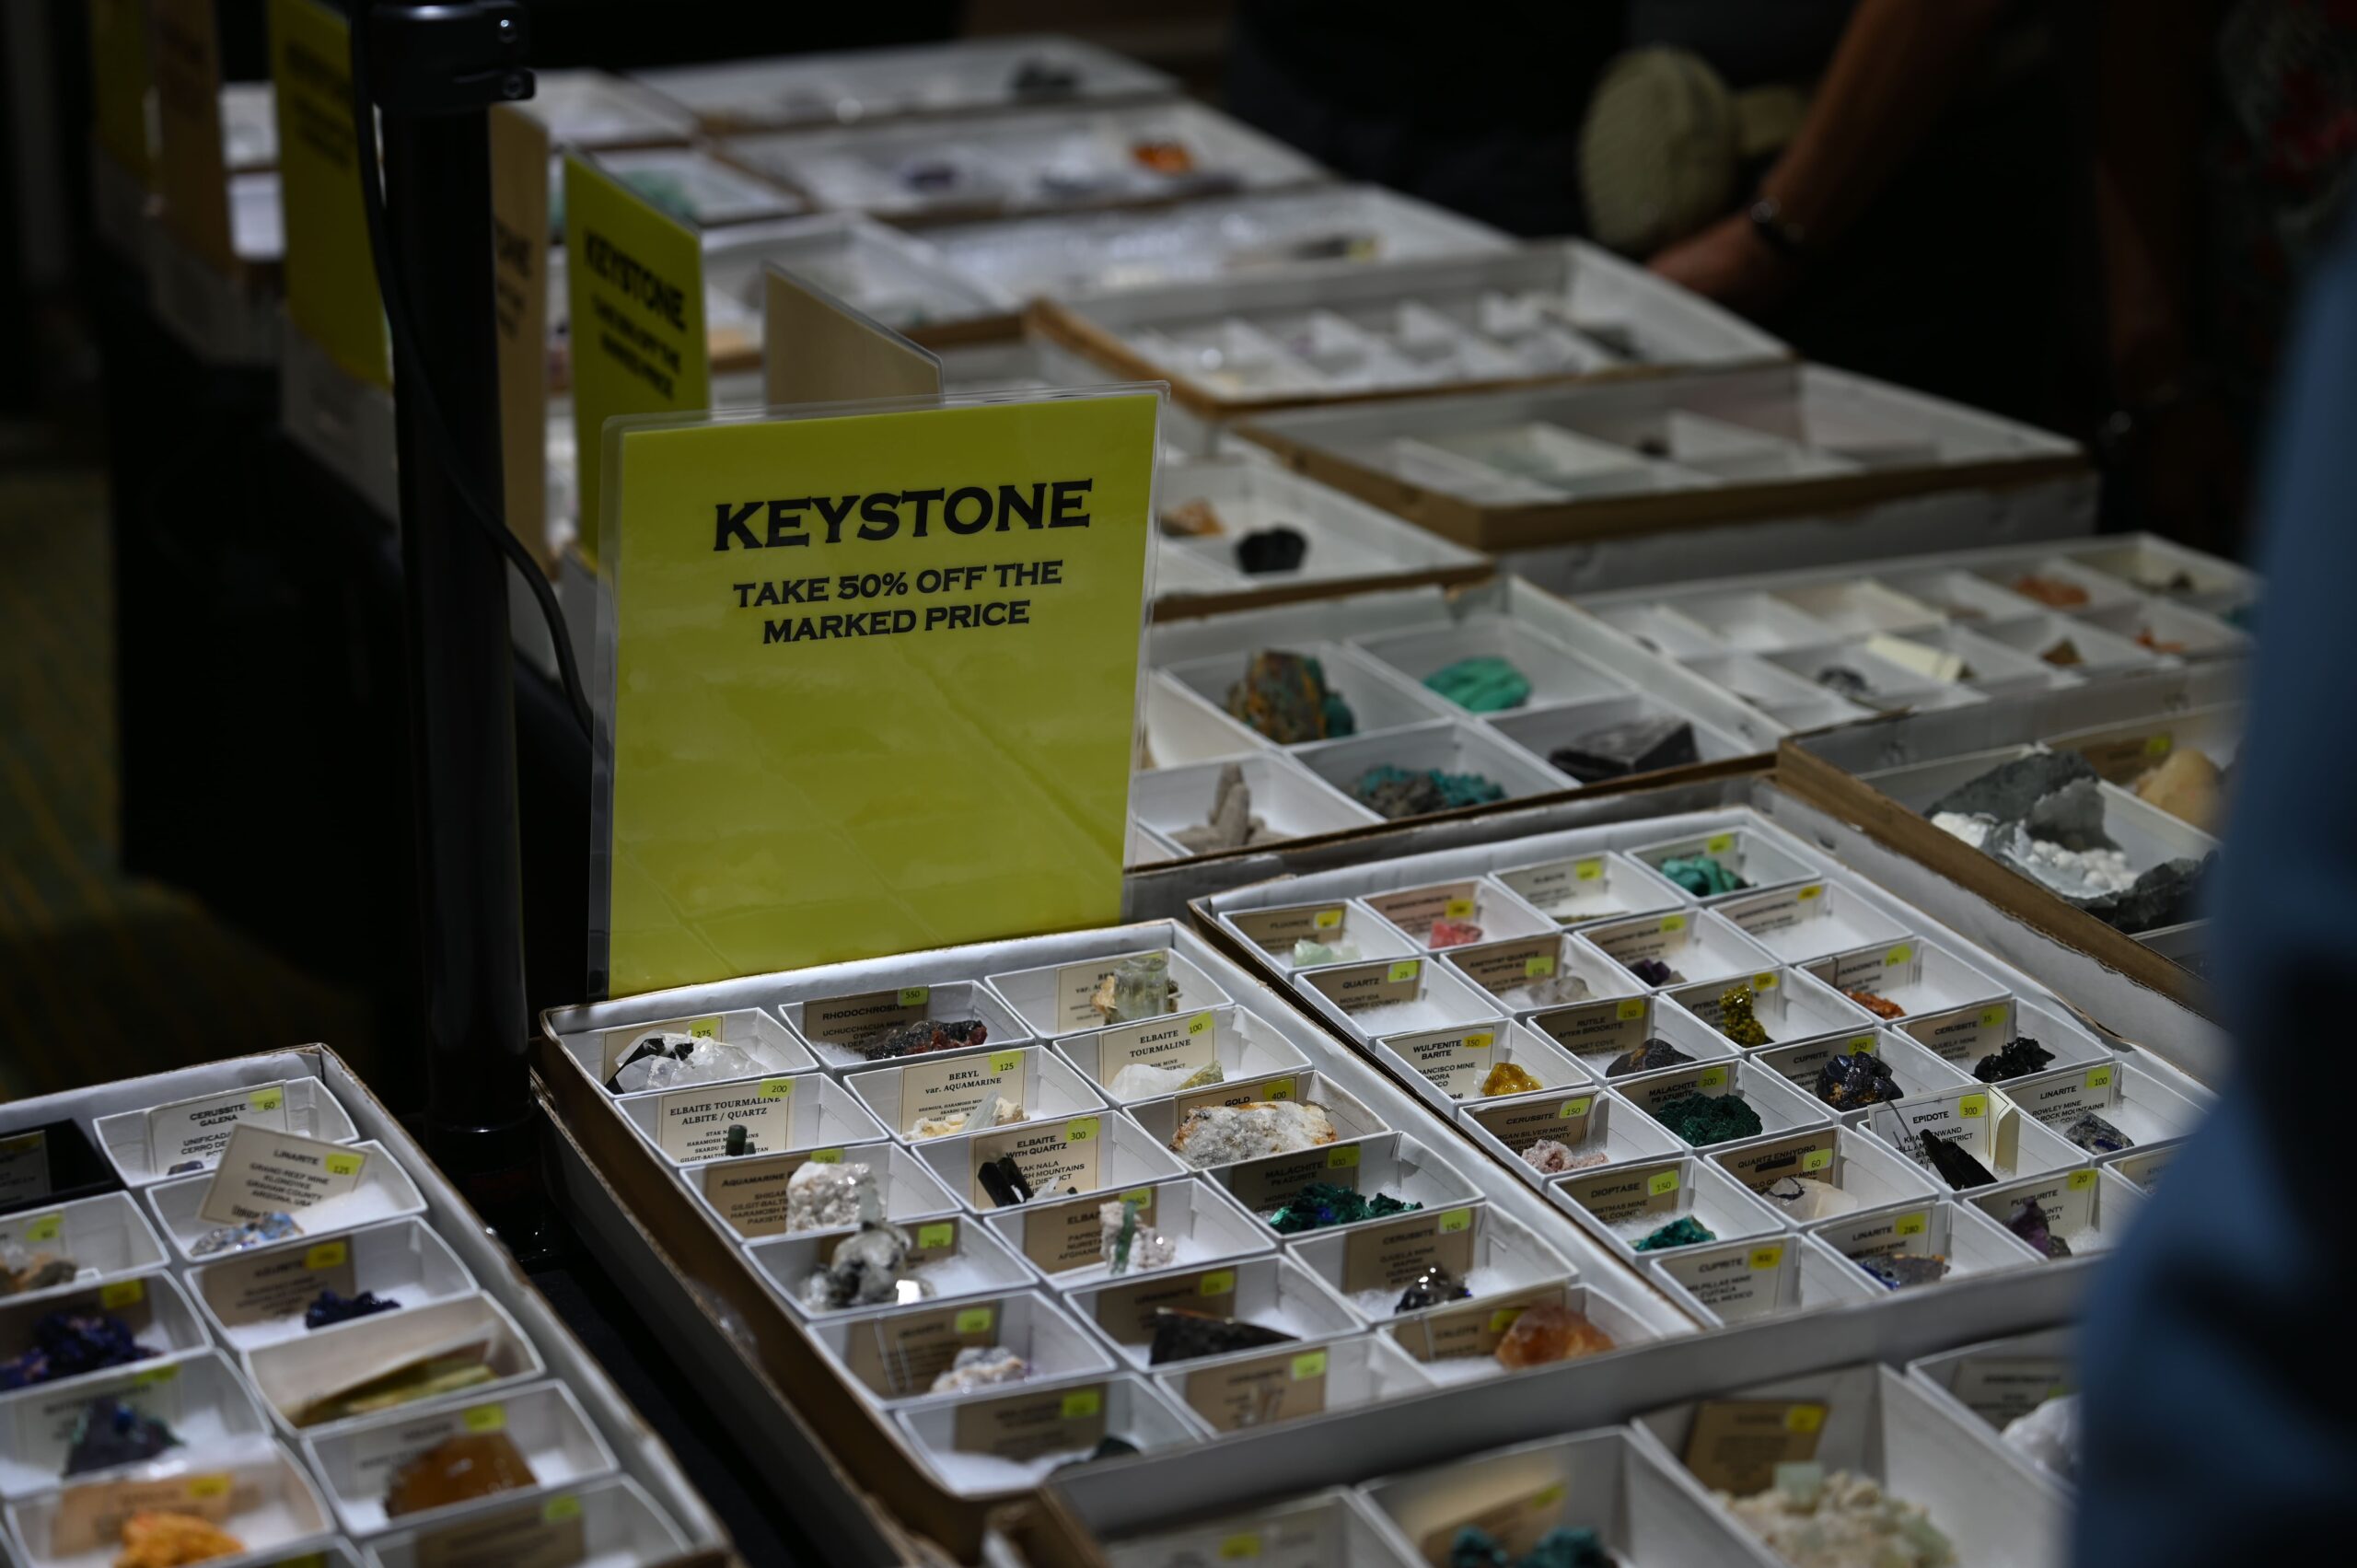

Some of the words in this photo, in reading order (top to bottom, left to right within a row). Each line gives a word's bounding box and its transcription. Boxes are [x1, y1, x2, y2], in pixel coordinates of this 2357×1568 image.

[585, 228, 687, 333] KEYSTONE
[714, 478, 1093, 552] KEYSTONE
[733, 576, 830, 609] TAKE
[838, 571, 909, 600] 50%
[916, 564, 988, 595] OFF
[993, 559, 1063, 587] THE
[762, 609, 917, 645] MARKED
[924, 599, 1030, 632] PRICE
[1342, 977, 1380, 990] QUARTZ
[905, 990, 921, 999] 550
[822, 1002, 908, 1020] RHODOCHROSIT
[1189, 1023, 1202, 1033] 100
[1576, 1016, 1606, 1027] RUTILE
[1934, 1020, 1978, 1035] CERUSSITE
[696, 1029, 712, 1039] 275
[1140, 1029, 1178, 1044] ELBAITE
[1129, 1039, 1191, 1058] TOURMALINE
[1412, 1040, 1462, 1053] WULFENITE
[1465, 1038, 1480, 1048] 350
[1421, 1050, 1452, 1060] BARITE
[1793, 1051, 1829, 1064] CUPRITE
[999, 1062, 1015, 1072] 125
[1163, 1058, 1178, 1066] MINE
[1417, 1064, 1456, 1075] RANCISCO
[1457, 1062, 1476, 1070] MINE
[948, 1070, 980, 1081] BERYL
[2094, 1076, 2107, 1086] 100
[772, 1085, 787, 1093] 200
[925, 1086, 942, 1095] var.
[943, 1076, 1002, 1092] AQUAMARINE
[1648, 1080, 1697, 1097] MALACHITE
[1271, 1090, 1287, 1100] 400
[2039, 1086, 2077, 1100] LINARITE
[263, 1101, 276, 1110] 60
[669, 1102, 712, 1117] ELBAITE
[714, 1097, 781, 1110] TOURMALINE
[944, 1099, 971, 1109] HARAMOSH
[1225, 1096, 1250, 1107] GOLD
[2032, 1104, 2062, 1117] ROWLEY
[2063, 1099, 2082, 1109] MINE
[190, 1102, 247, 1121] CERUSSITE
[681, 1112, 718, 1125] ALBITE
[727, 1107, 768, 1121] QUARTZ
[1566, 1107, 1581, 1116] 150
[1912, 1110, 1950, 1124] EPIDOTE
[1964, 1107, 1978, 1116] 300
[199, 1114, 238, 1127] GALENA
[1505, 1112, 1555, 1125] CERUSSITE
[1070, 1131, 1086, 1141] 300
[1520, 1128, 1548, 1138] SILVER
[1549, 1125, 1569, 1133] MINE
[180, 1144, 214, 1156] CERRO
[215, 1140, 227, 1150] DE
[687, 1136, 722, 1147] HARAMOSH
[1016, 1134, 1057, 1149] ELBAITE
[695, 1144, 720, 1154] SKARDU
[1005, 1148, 1028, 1159] WITH
[1028, 1142, 1068, 1156] QUARTZ
[273, 1149, 320, 1166] LINARITE
[679, 1151, 729, 1164] GILGIT-BALTIST
[1737, 1155, 1772, 1168] QUARTZ
[1773, 1144, 1817, 1161] ENHYDRO
[1017, 1163, 1036, 1172] TAK
[1036, 1160, 1059, 1169] NALA
[1265, 1160, 1324, 1179] MALACHITE
[1811, 1159, 1821, 1168] 60
[1036, 1163, 1086, 1178] MOUNTAINS
[1798, 1169, 1817, 1179] MINE
[721, 1172, 784, 1188] AQUAMARINE
[2077, 1175, 2088, 1183] 20
[1590, 1182, 1641, 1199] DIOPTASE
[1656, 1181, 1672, 1191] 150
[731, 1198, 788, 1211] GILGIT-BALTIS
[1627, 1199, 1648, 1208] MINE
[2010, 1189, 2059, 1207] PUURITE
[730, 1208, 782, 1220] HARAMOSH
[1067, 1211, 1100, 1225] ELBA
[1382, 1228, 1435, 1246] CERUSSITE
[1852, 1225, 1893, 1241] LINARITE
[1067, 1238, 1102, 1250] NURISTA
[1058, 1247, 1102, 1261] AFGHANIS
[1699, 1258, 1743, 1272] CUPRITE
